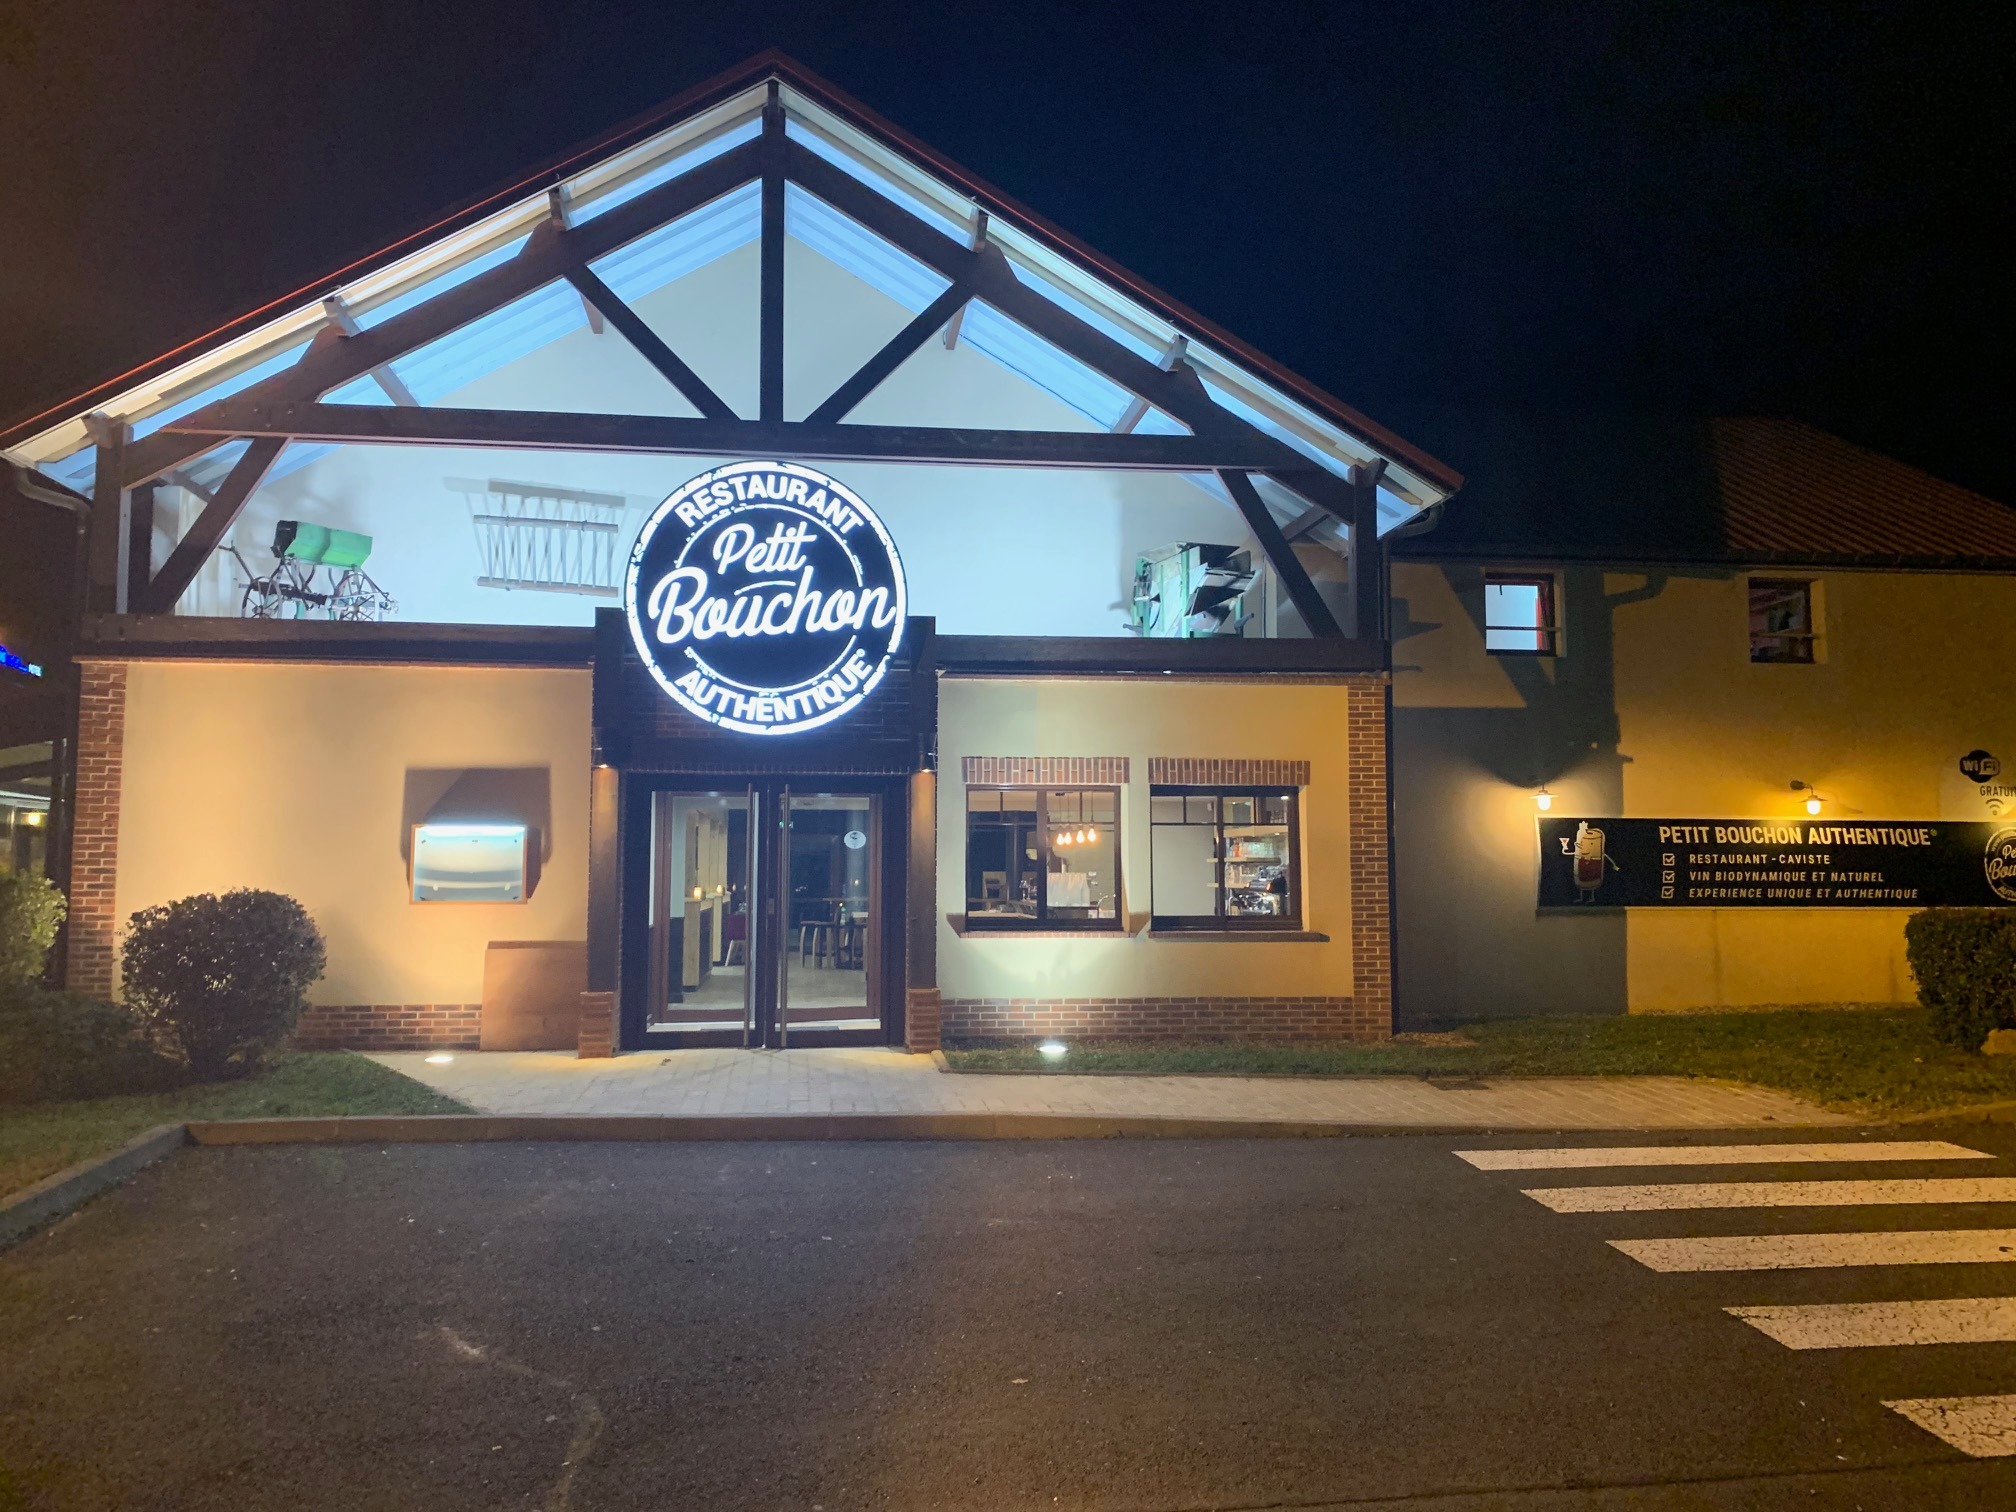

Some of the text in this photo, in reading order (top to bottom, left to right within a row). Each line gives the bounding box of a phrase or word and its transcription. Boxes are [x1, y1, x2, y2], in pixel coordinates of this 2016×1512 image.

[675, 474, 864, 534] RESTAURANT
[712, 521, 817, 575] Petit
[648, 565, 896, 644] Bouchon
[1659, 826, 1709, 843] PETIT
[1714, 826, 1802, 844] BOUCHON
[1689, 854, 1767, 864] RESTAURANT
[1778, 854, 1830, 865] CAVISTE
[1689, 871, 1884, 882] VIN BIODYNAMIQUE ET NATUREL
[1688, 888, 1918, 899] EXPERIENCE UNIQUE ET AUTHENTIQUE
